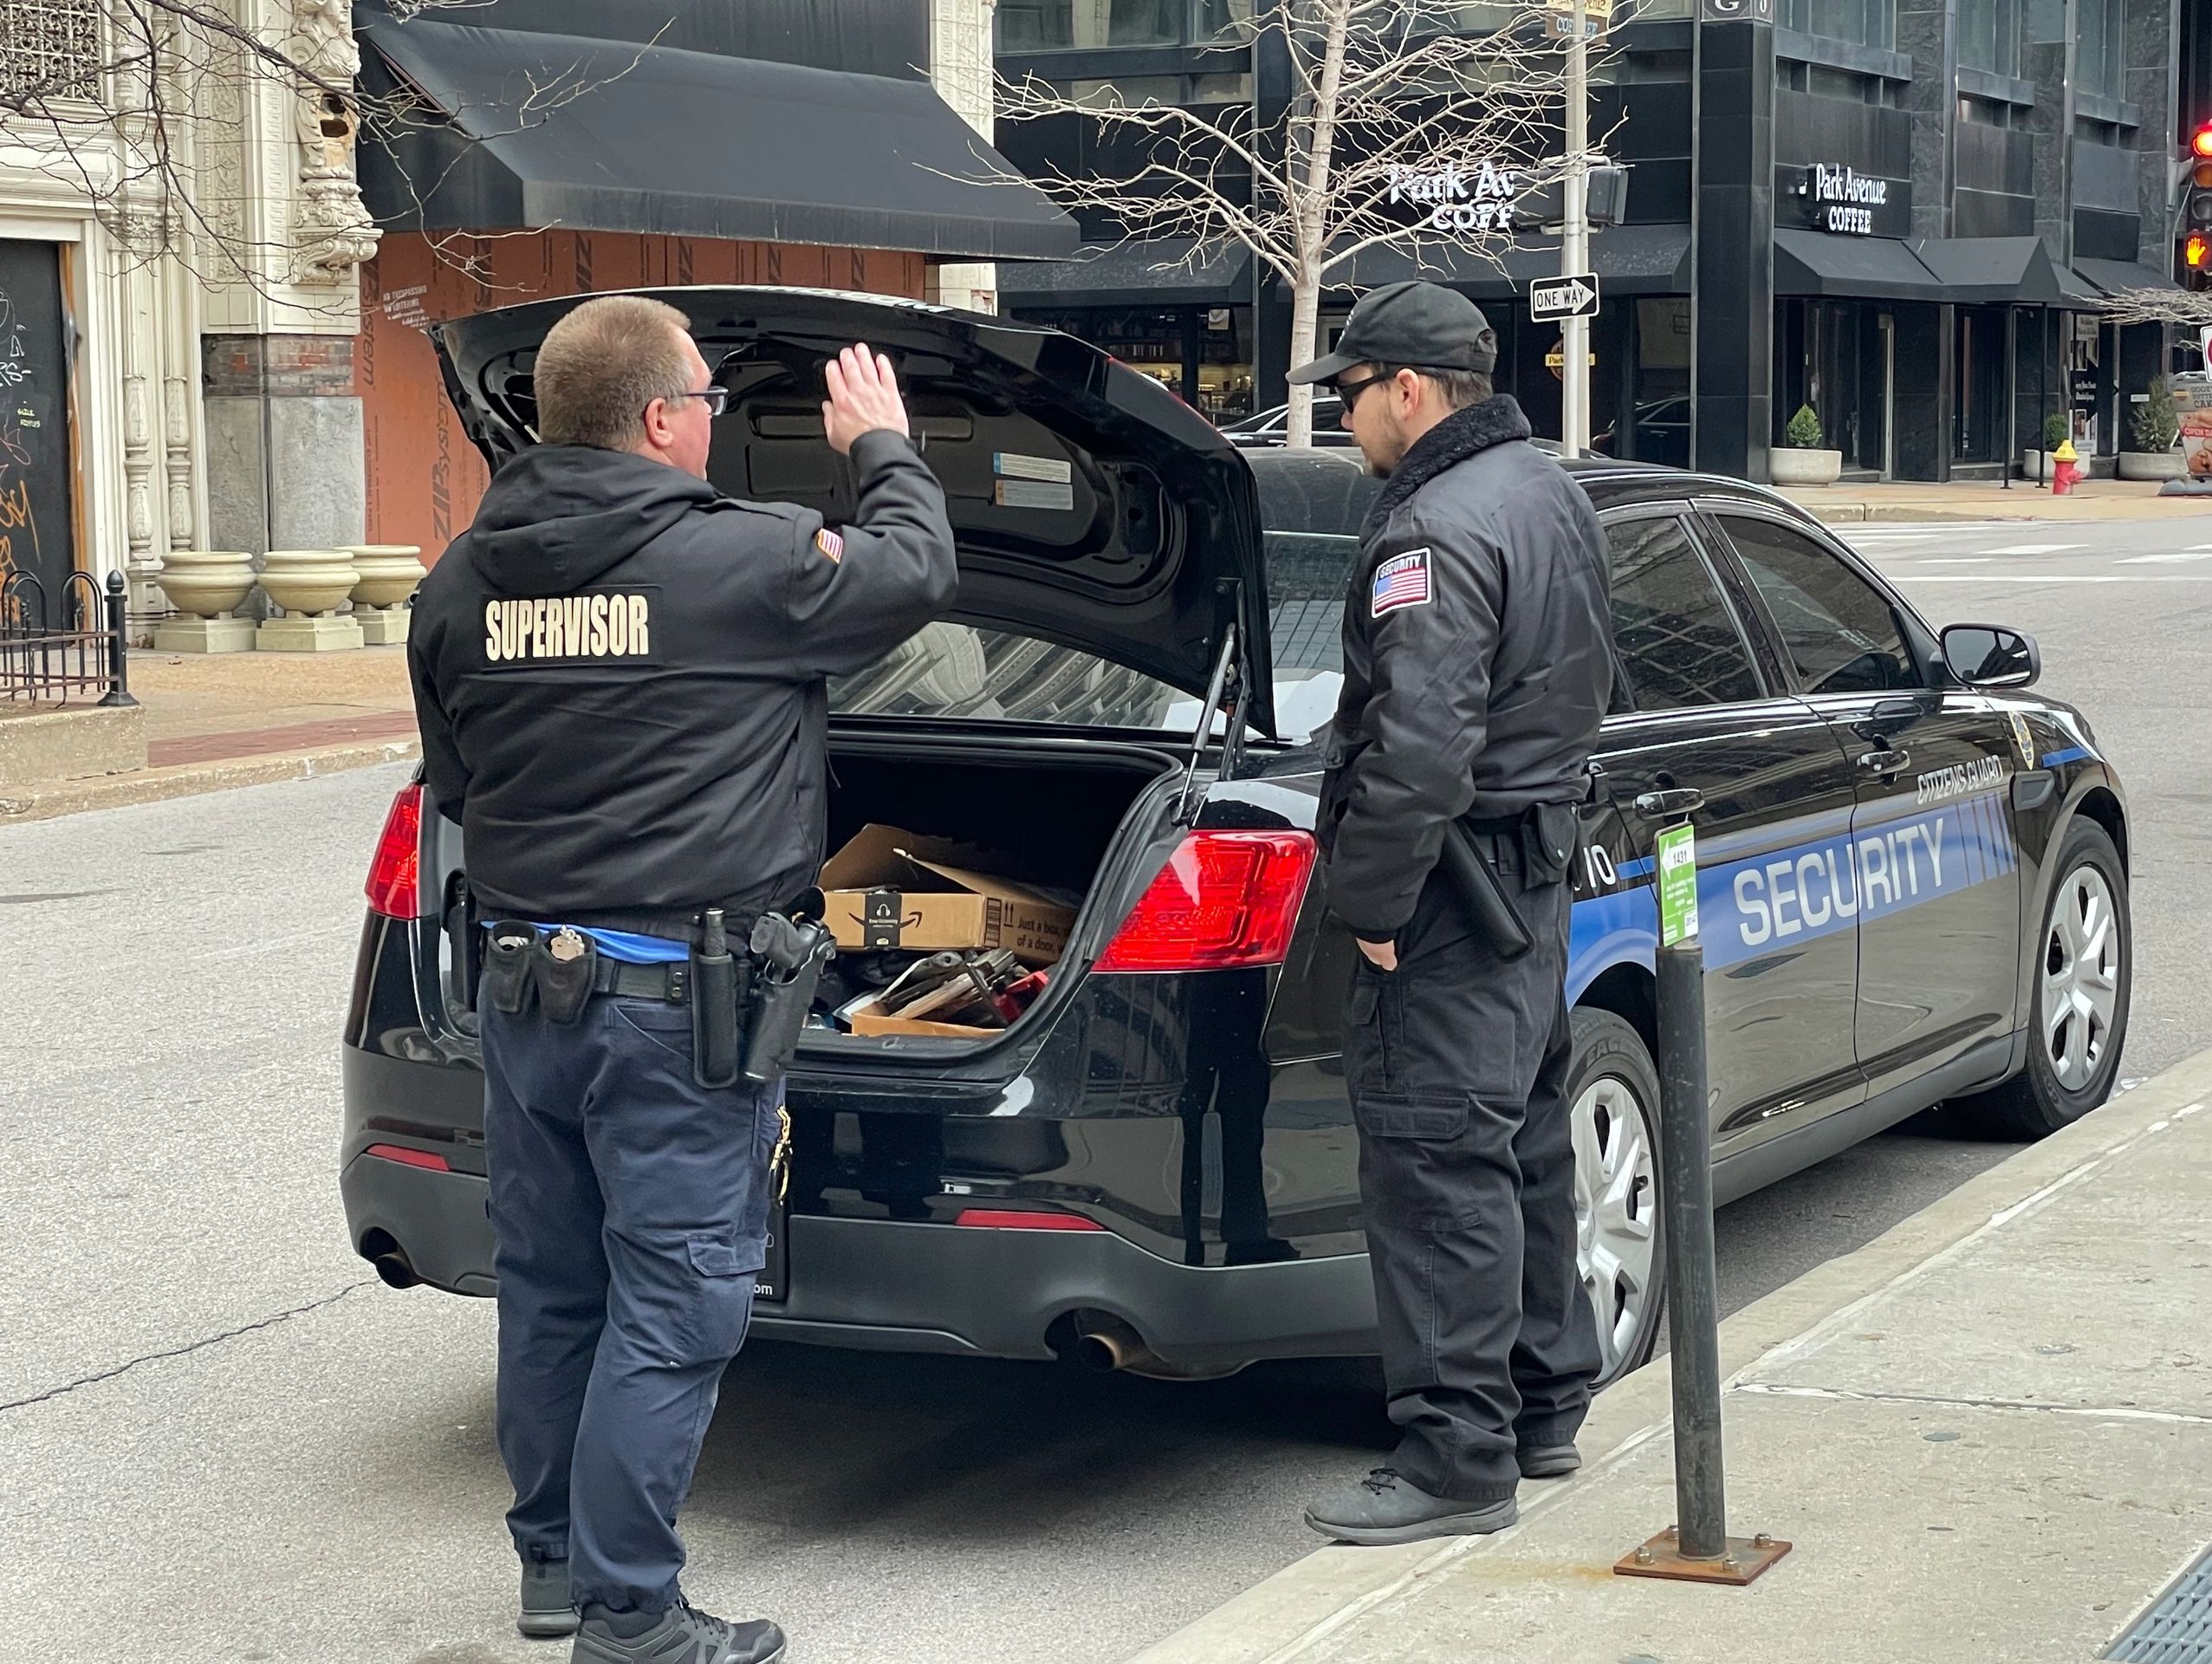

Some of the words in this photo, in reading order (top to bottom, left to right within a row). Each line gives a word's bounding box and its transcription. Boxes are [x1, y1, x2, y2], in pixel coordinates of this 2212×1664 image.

[1556, 16, 1599, 36] COFEE
[1816, 162, 1843, 201] Park
[1844, 166, 1886, 205] Avenue
[1433, 203, 1515, 230] COFF
[1828, 205, 1871, 234] COFFEE
[1536, 290, 1558, 308] ONE
[1563, 288, 1585, 305] WAY
[1379, 555, 1421, 579] SECURITY
[485, 594, 649, 661] SUPERVISOR
[1917, 764, 1967, 804] CITIZENS
[1966, 754, 2004, 791] GUARD
[1673, 848, 1687, 865] 1431
[1734, 817, 1943, 946] SECURITY
[1017, 917, 1035, 931] Just
[1017, 934, 1027, 947] of
